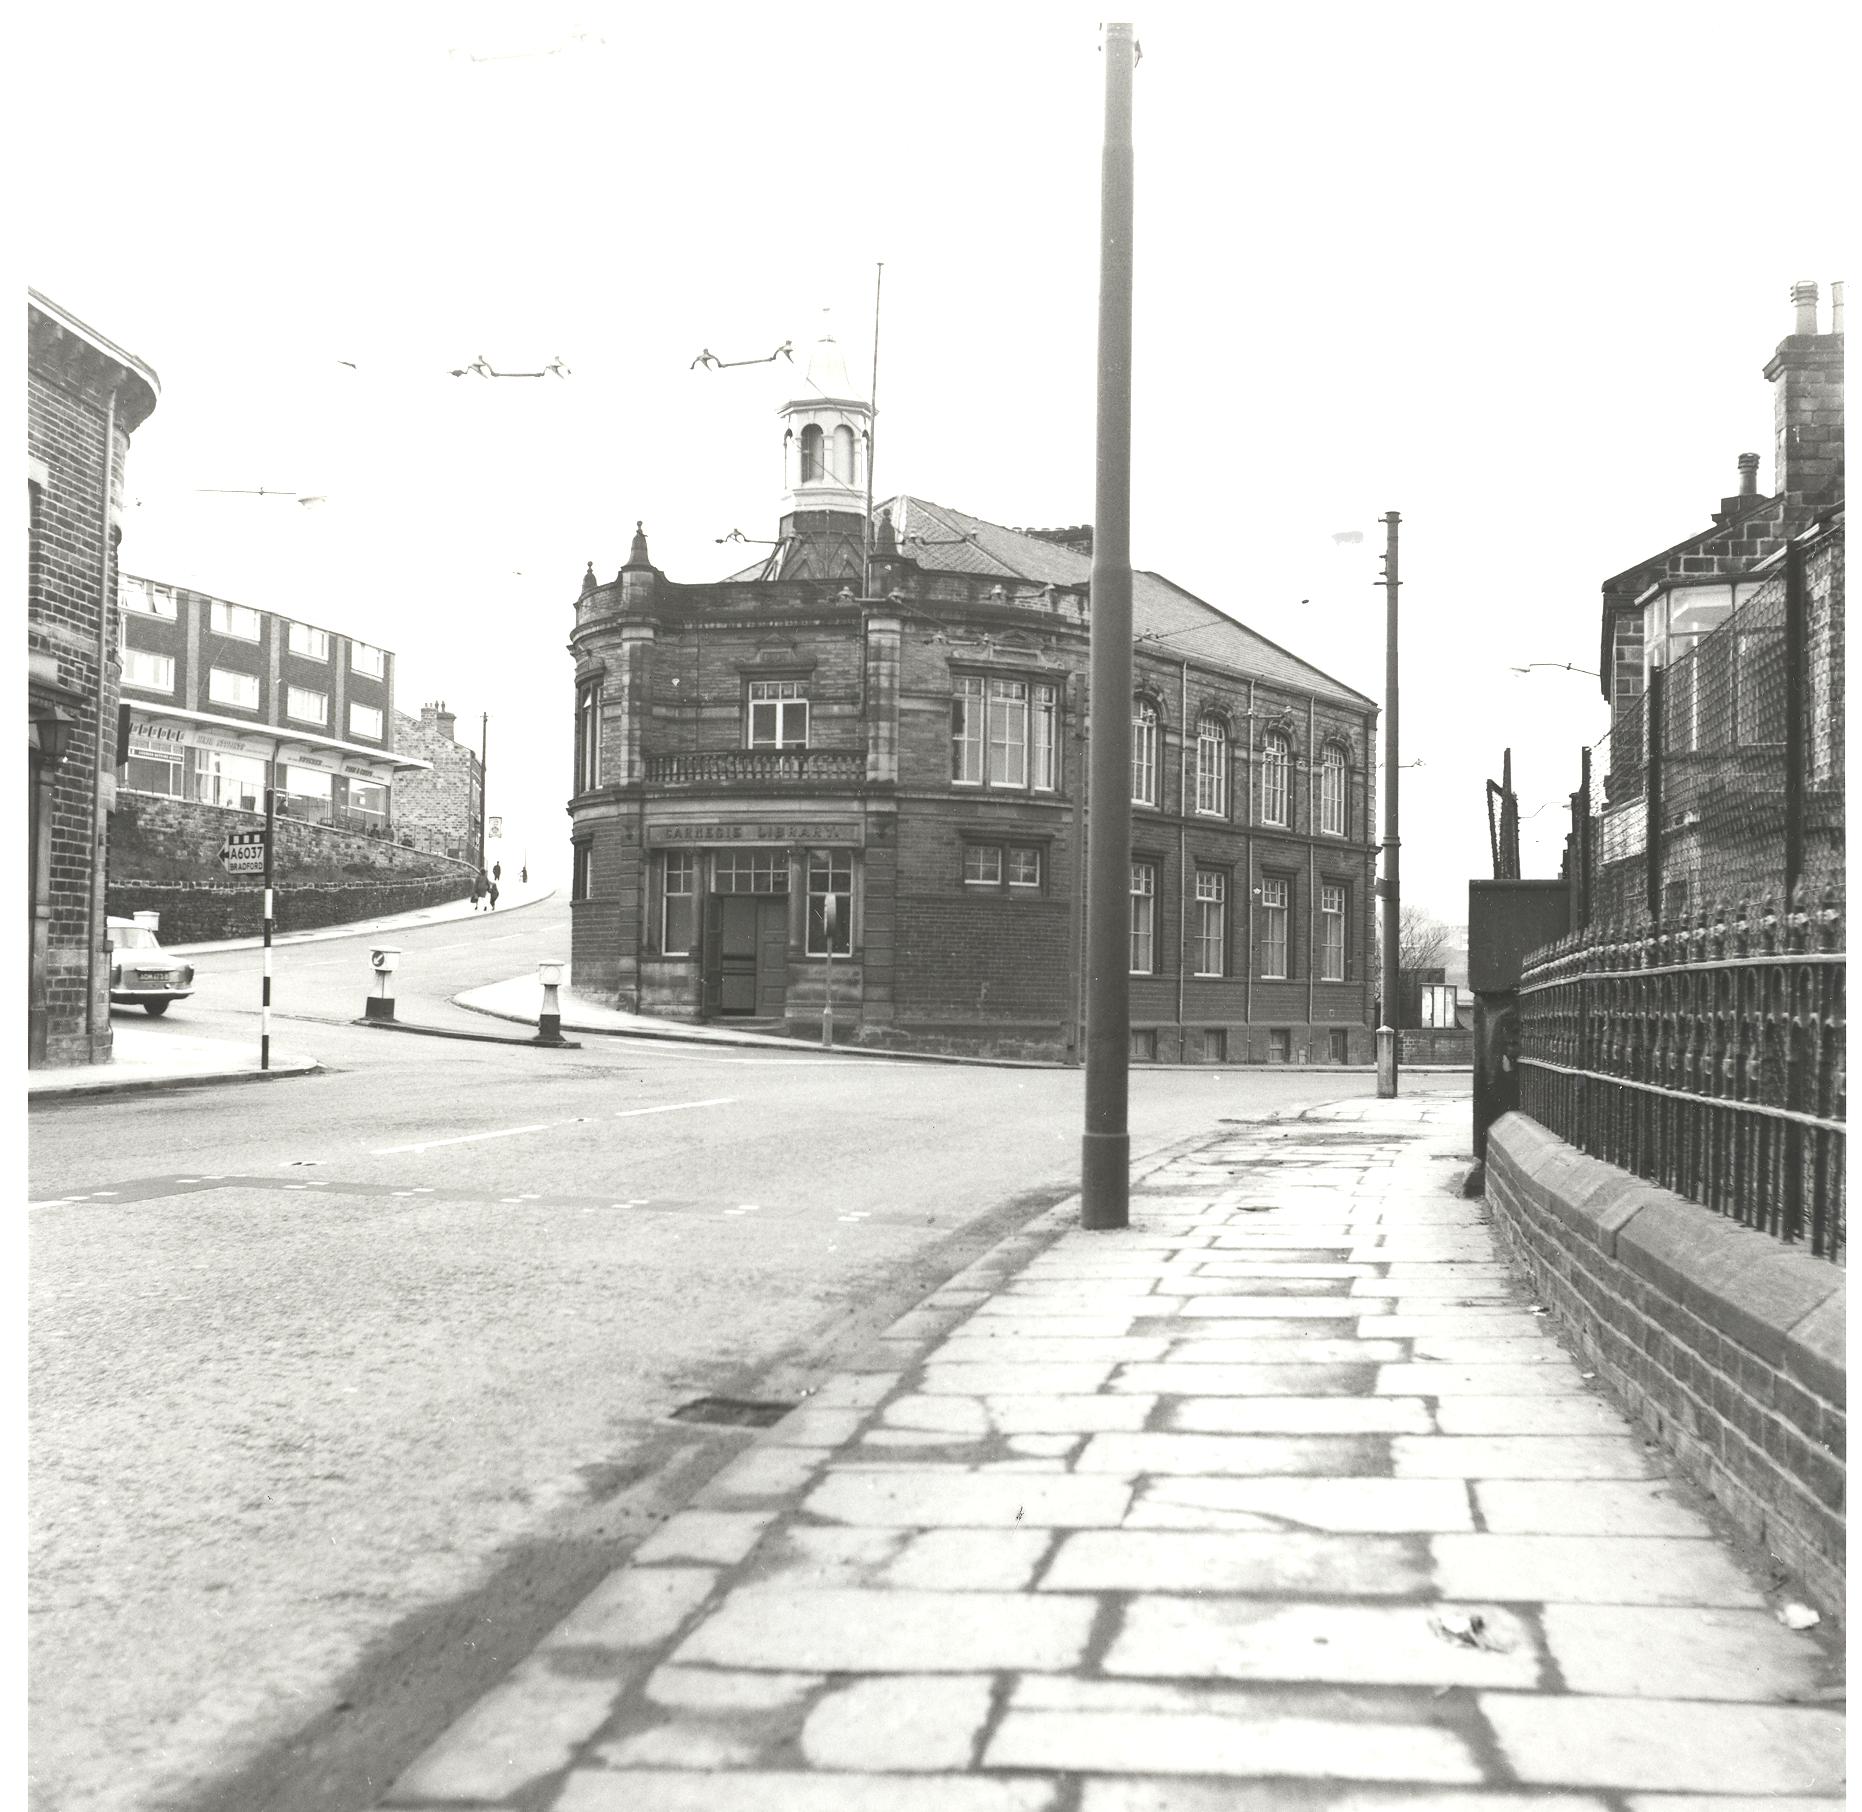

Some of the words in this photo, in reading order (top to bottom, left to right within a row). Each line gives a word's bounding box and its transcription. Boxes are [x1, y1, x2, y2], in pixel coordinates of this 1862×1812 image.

[664, 826, 743, 840] CARNEGIE
[230, 846, 263, 860] A6037
[229, 862, 263, 871] BRADFORD
